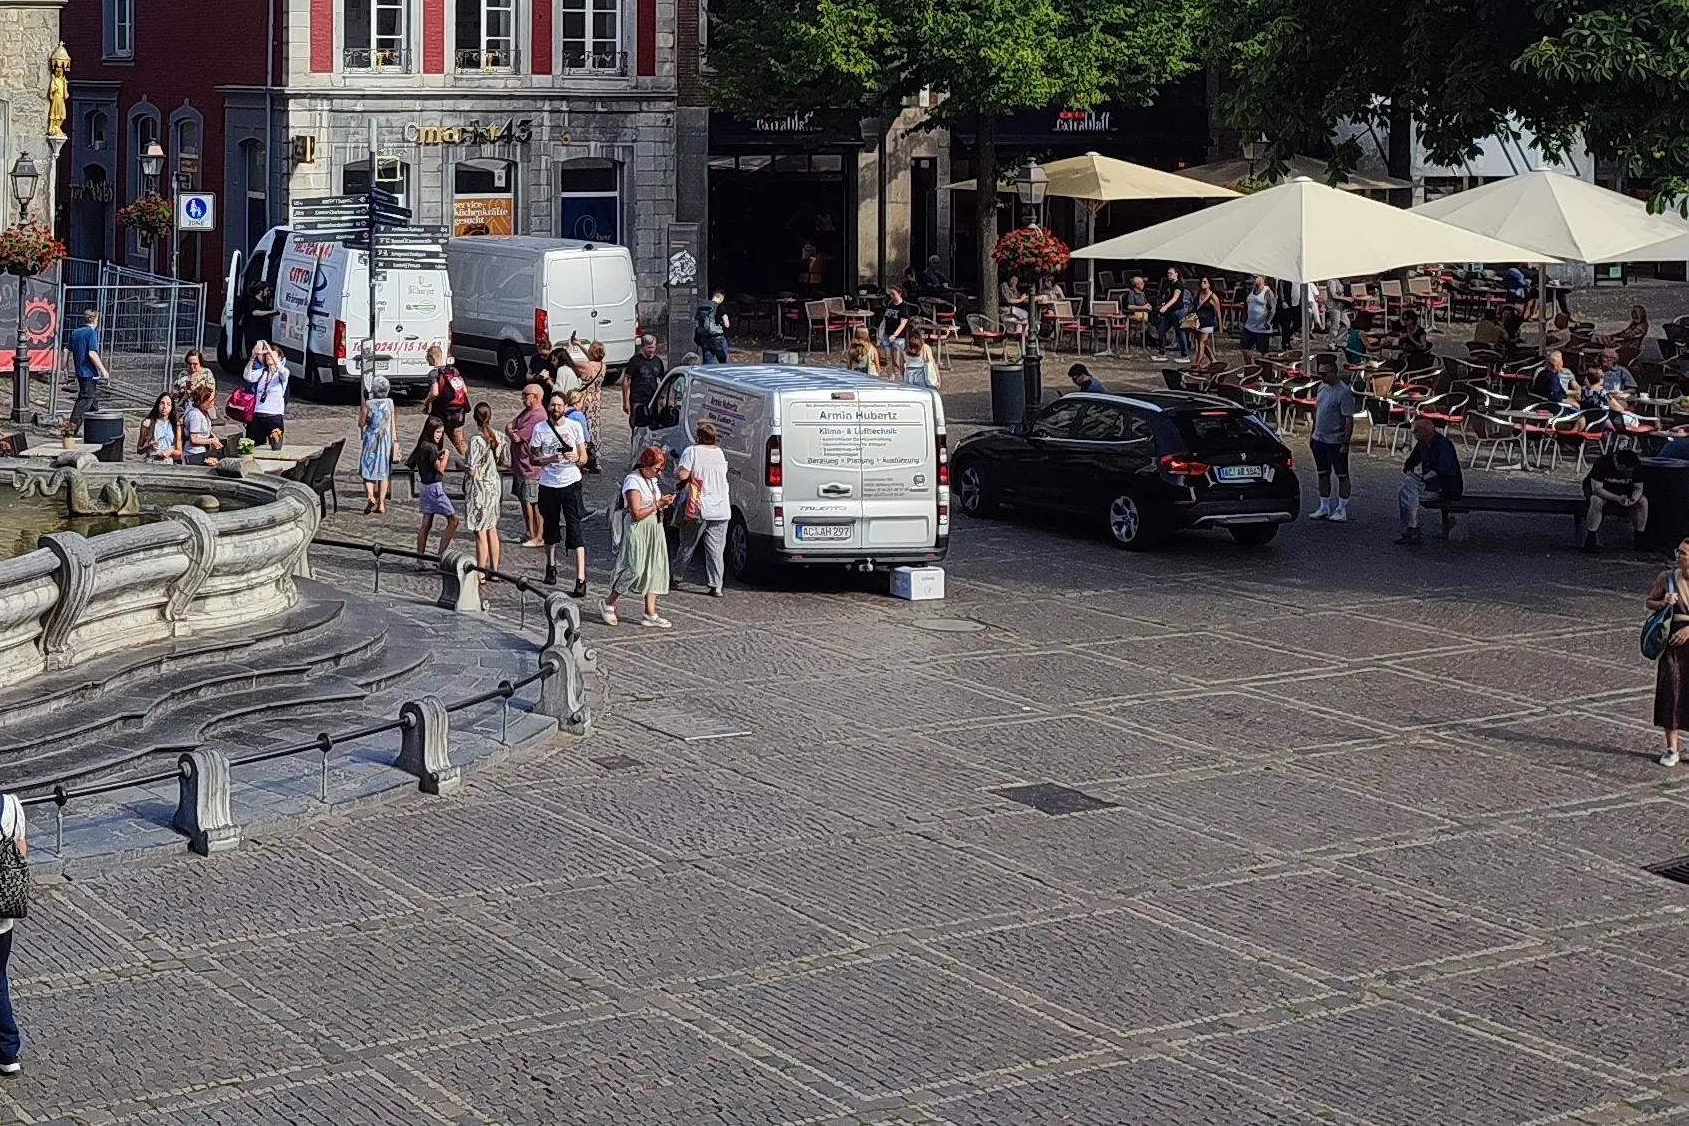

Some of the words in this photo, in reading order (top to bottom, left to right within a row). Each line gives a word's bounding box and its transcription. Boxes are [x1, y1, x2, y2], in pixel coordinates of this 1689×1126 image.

[819, 410, 852, 420] Armin
[855, 410, 898, 420] Hubertz
[832, 527, 849, 536] 297
